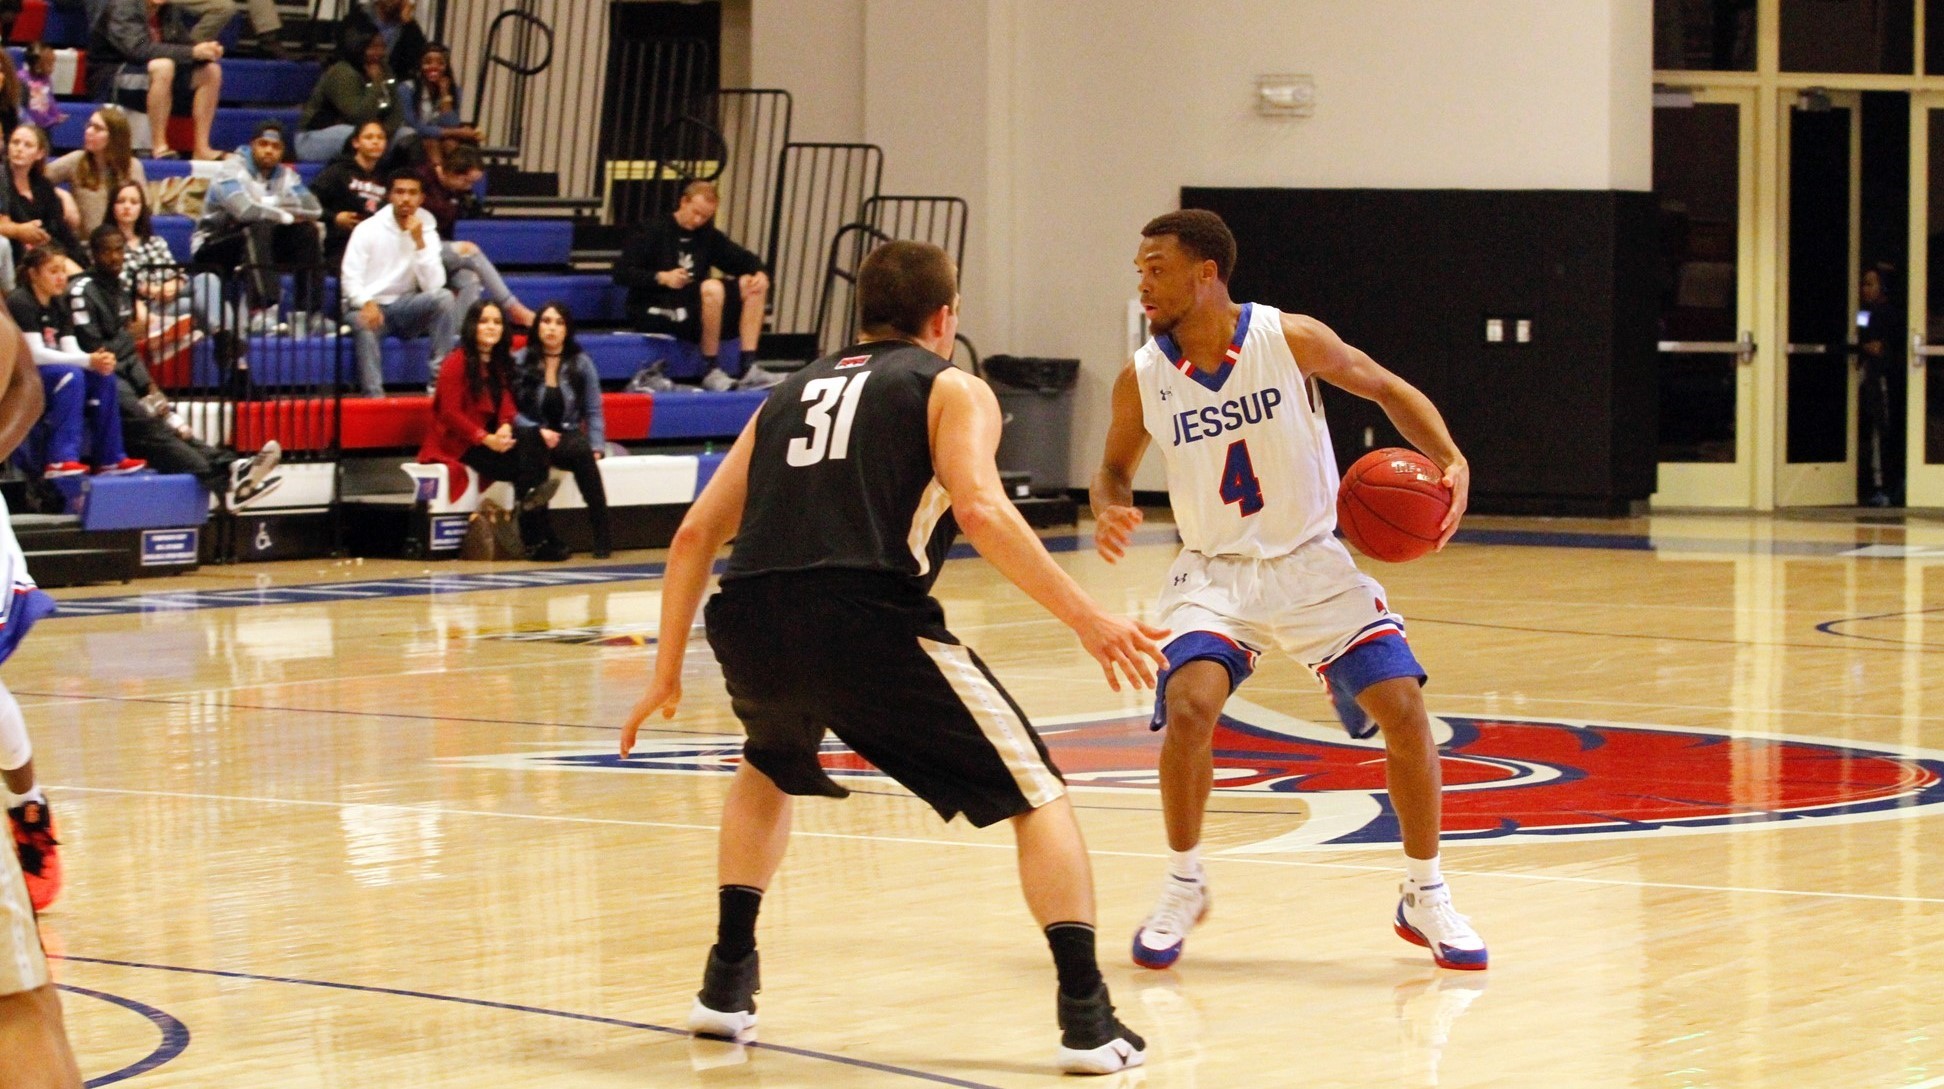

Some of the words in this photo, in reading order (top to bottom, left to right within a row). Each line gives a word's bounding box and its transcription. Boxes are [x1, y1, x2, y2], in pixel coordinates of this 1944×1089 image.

[786, 370, 872, 467] 31
[1173, 388, 1281, 446] JESSUP
[1219, 438, 1264, 518] 4
